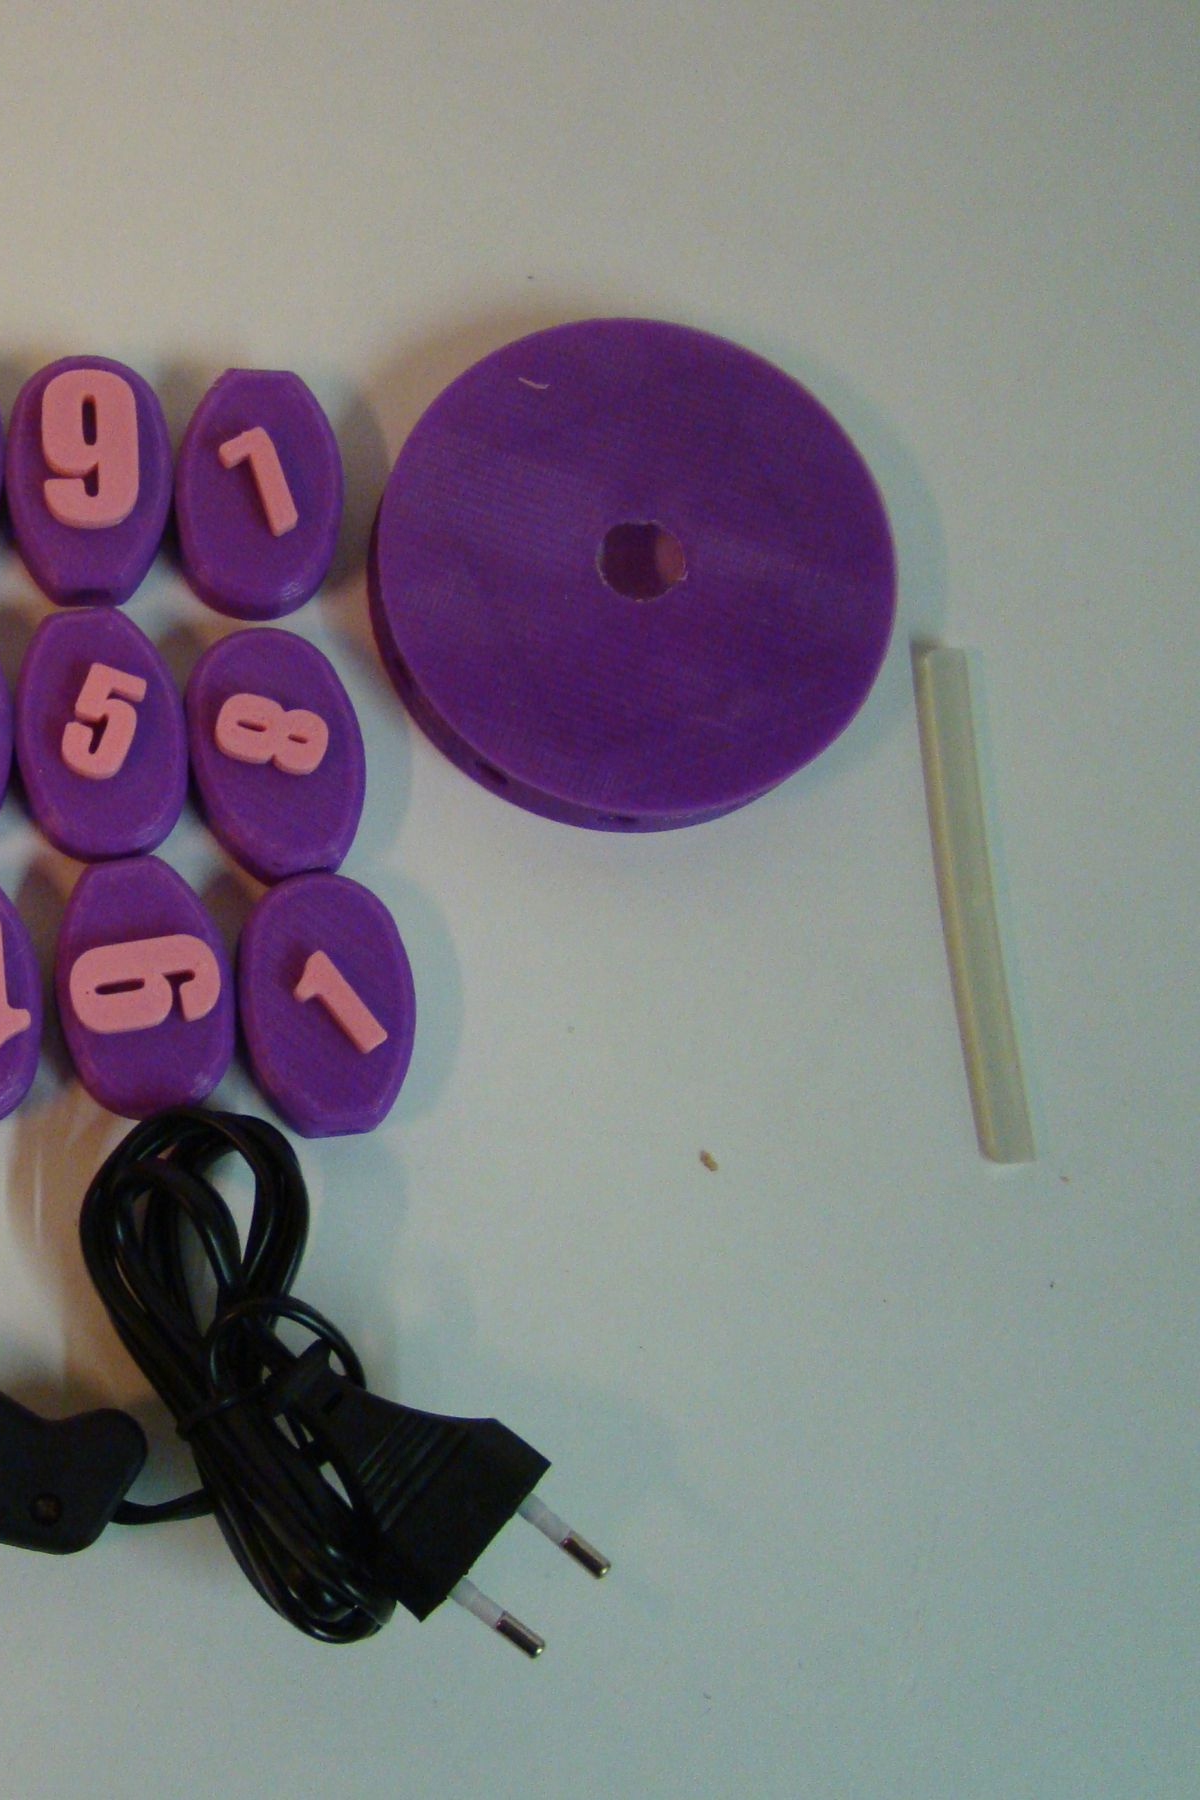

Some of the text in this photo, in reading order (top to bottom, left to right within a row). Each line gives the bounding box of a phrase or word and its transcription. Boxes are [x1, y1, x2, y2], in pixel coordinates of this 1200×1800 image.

[61, 662, 147, 779] 5
[214, 692, 330, 775] 8
[293, 949, 388, 1054] 1
